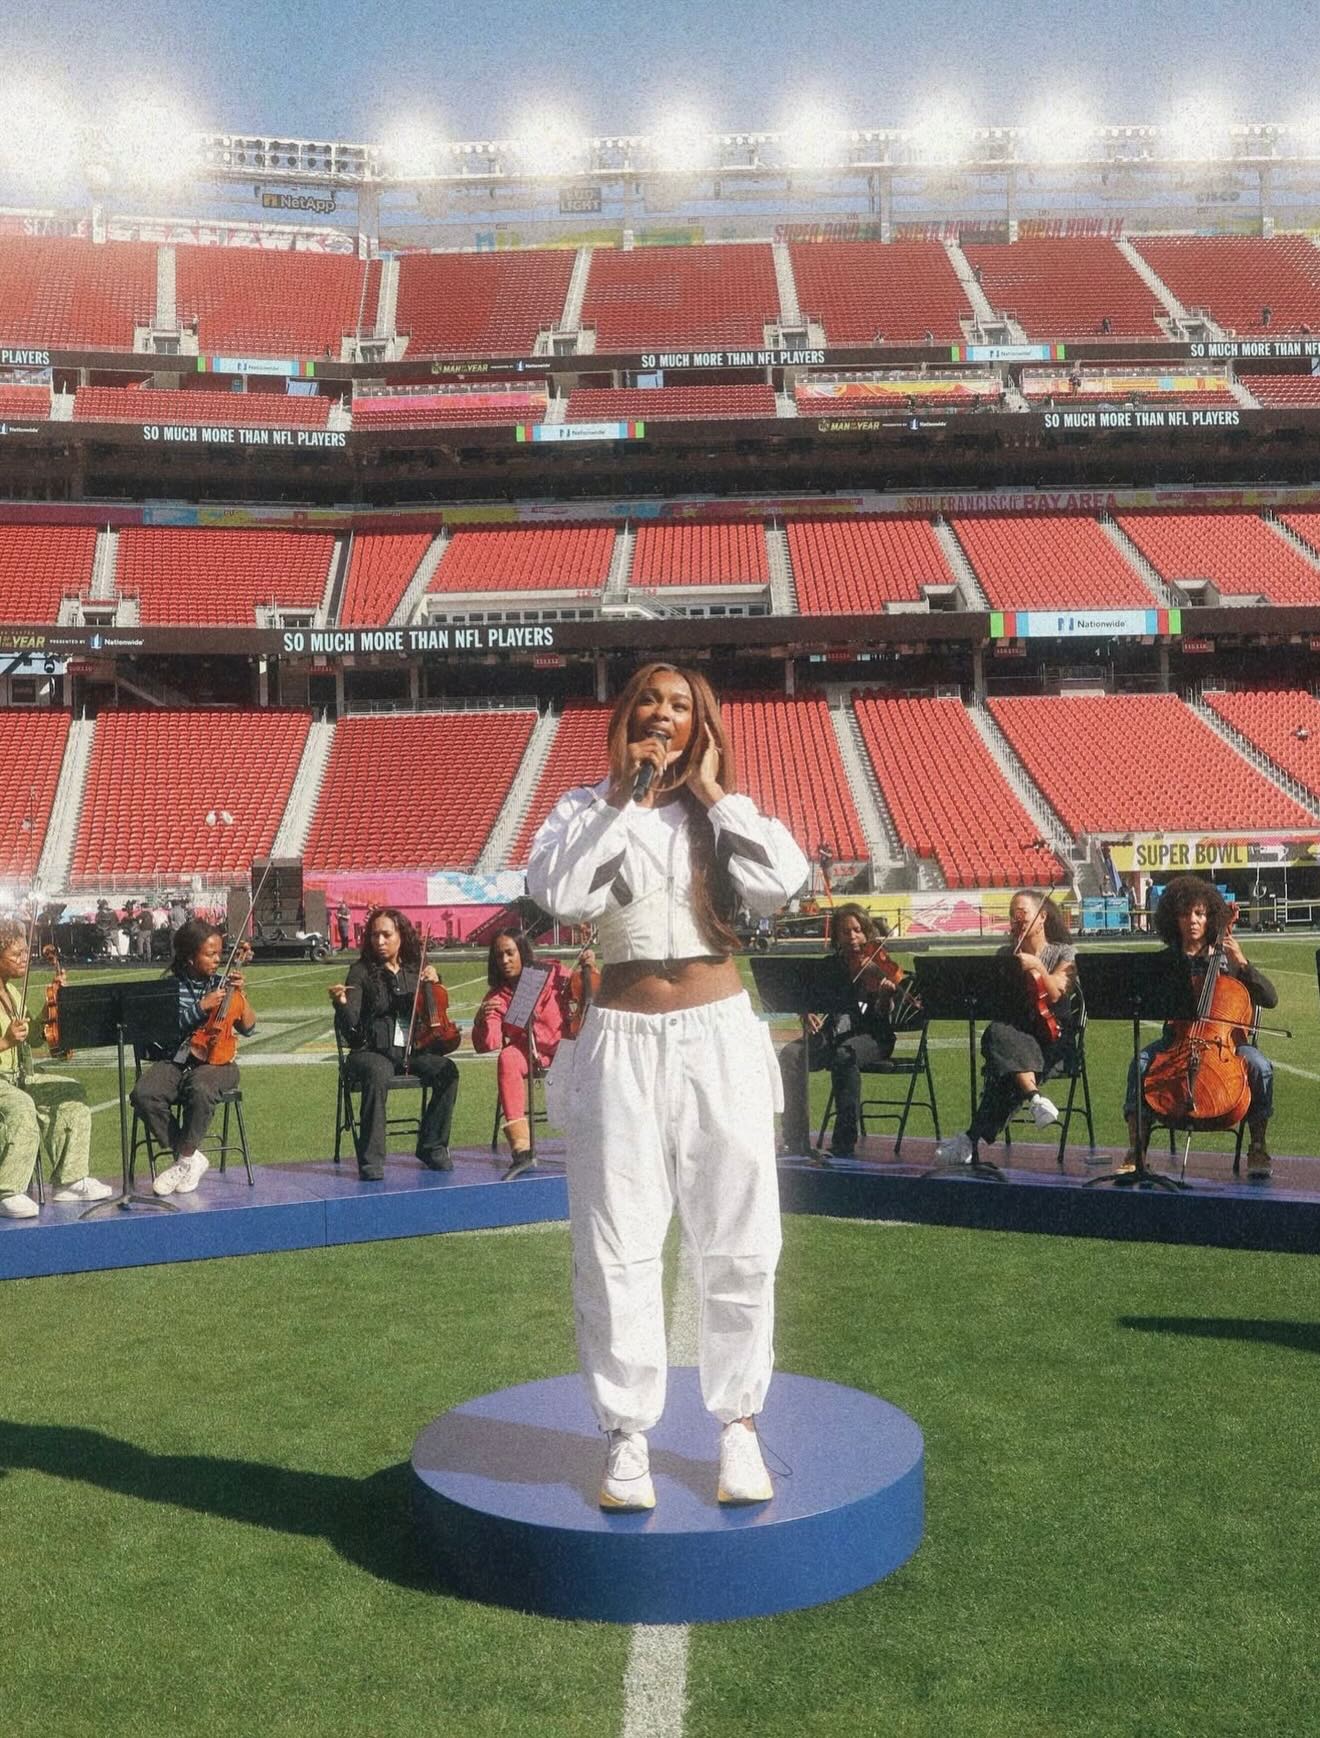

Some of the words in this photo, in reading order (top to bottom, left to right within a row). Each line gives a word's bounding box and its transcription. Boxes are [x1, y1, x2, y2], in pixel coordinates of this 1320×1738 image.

[281, 196, 336, 213] NetApp
[561, 201, 600, 211] LIGHT
[1190, 343, 1204, 357] SO
[1208, 343, 1238, 356] MUCH
[1242, 343, 1271, 356] MORE
[1274, 342, 1301, 355] THAN
[2, 350, 50, 365] PLAYERS
[642, 355, 655, 368] SO
[660, 354, 689, 367] MUCH
[693, 353, 722, 366] MORE
[727, 352, 754, 365] THAN
[758, 352, 776, 364] NFL
[780, 351, 825, 364] PLAYERS
[468, 364, 489, 373] YEAR
[830, 422, 850, 431] MAN
[858, 421, 880, 430] YEAR
[1044, 413, 1059, 428] SO
[1064, 413, 1096, 427] MUCH
[1100, 413, 1131, 427] MORE
[1135, 412, 1164, 426] THAN
[1168, 412, 1188, 426] NFL
[1192, 411, 1240, 425] PLAYERS
[143, 426, 158, 440] SO
[163, 427, 197, 441] MUCH
[201, 428, 235, 443] MORE
[239, 429, 268, 444] THAN
[273, 431, 294, 445] NFL
[298, 431, 346, 447] PLAYERS
[1024, 494, 1061, 510] BAY
[1067, 492, 1117, 509] AREA
[1077, 619, 1126, 629] Nationwide
[12, 636, 46, 648] YEAR
[104, 638, 144, 646] Nationwide
[283, 632, 304, 652] SO
[310, 632, 355, 651] MUCH
[361, 631, 403, 650] MORE
[409, 630, 449, 649] THAN
[455, 629, 483, 648] NFL
[488, 627, 554, 647] PLAYERS
[1137, 843, 1190, 866] SUPER
[1195, 843, 1243, 864] BOWL
